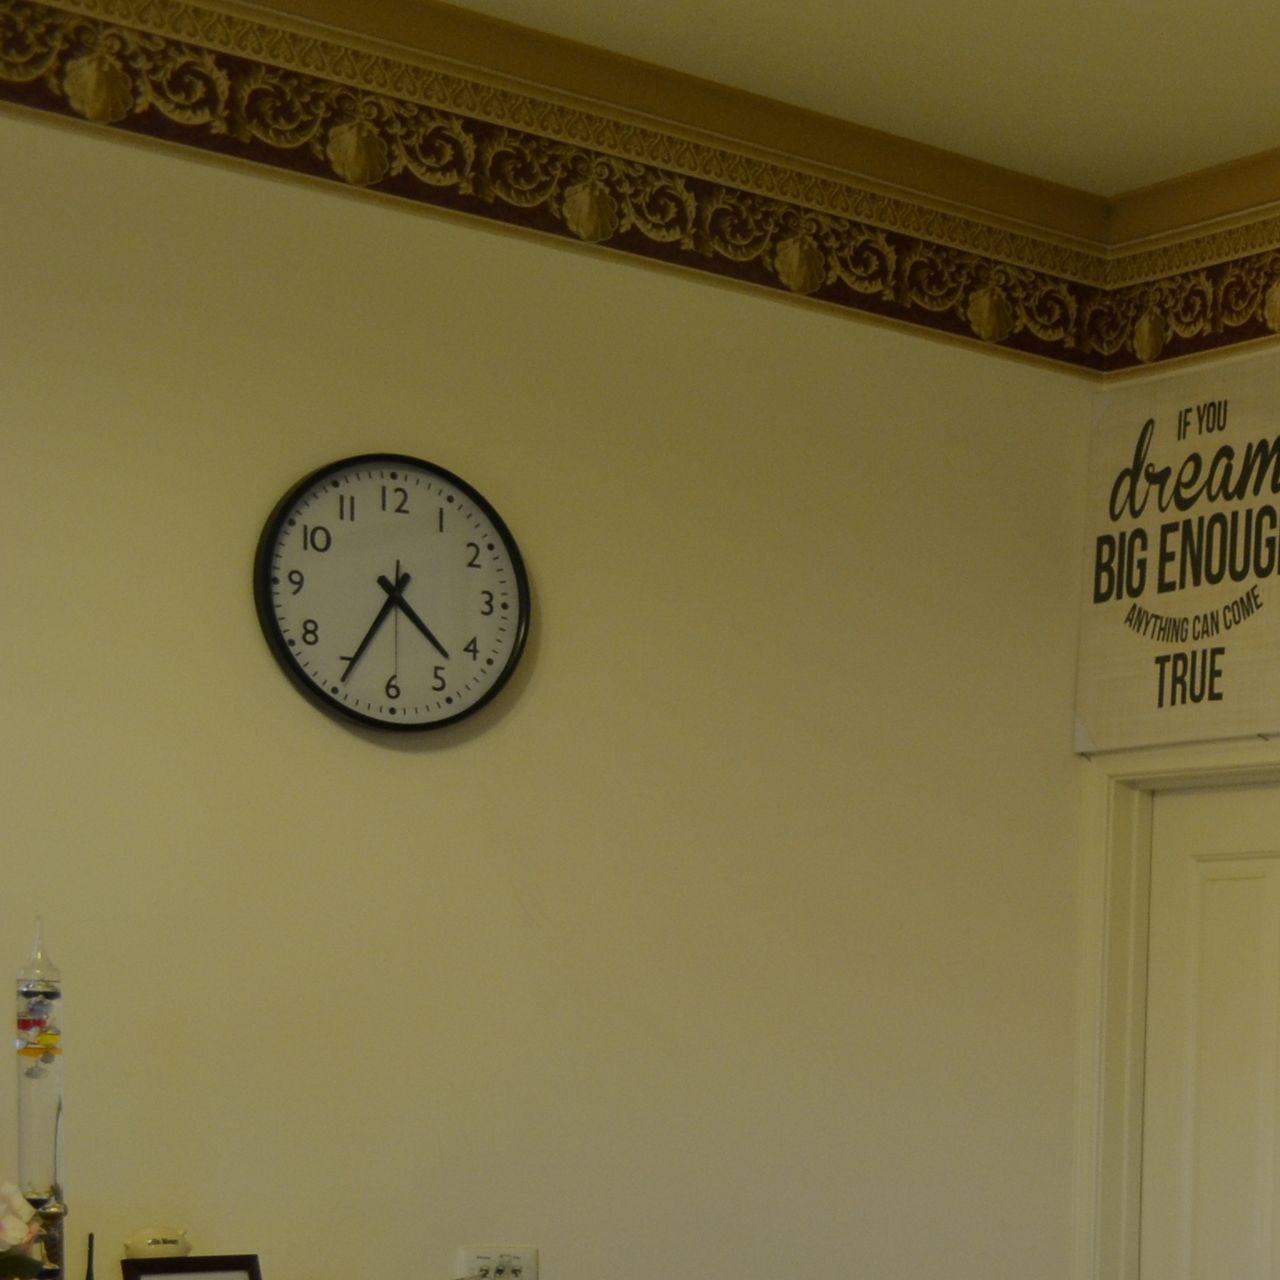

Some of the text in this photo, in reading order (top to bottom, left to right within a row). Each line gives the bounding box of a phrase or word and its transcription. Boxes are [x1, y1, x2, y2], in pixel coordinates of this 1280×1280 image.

[1177, 399, 1228, 441] IF YOU
[339, 494, 356, 522] 11
[381, 485, 410, 514] 12
[438, 507, 444, 533] 1
[303, 524, 332, 553] 10
[465, 542, 482, 569] 2
[1093, 527, 1148, 604] BIG
[287, 569, 305, 596] 9
[480, 591, 494, 616] 3
[1124, 584, 1264, 643] ANYTHING CAN COME
[301, 619, 319, 646] 8
[463, 636, 480, 661] 4
[385, 674, 401, 699] 6
[431, 666, 447, 692] 5
[1154, 647, 1226, 708] TRUE
